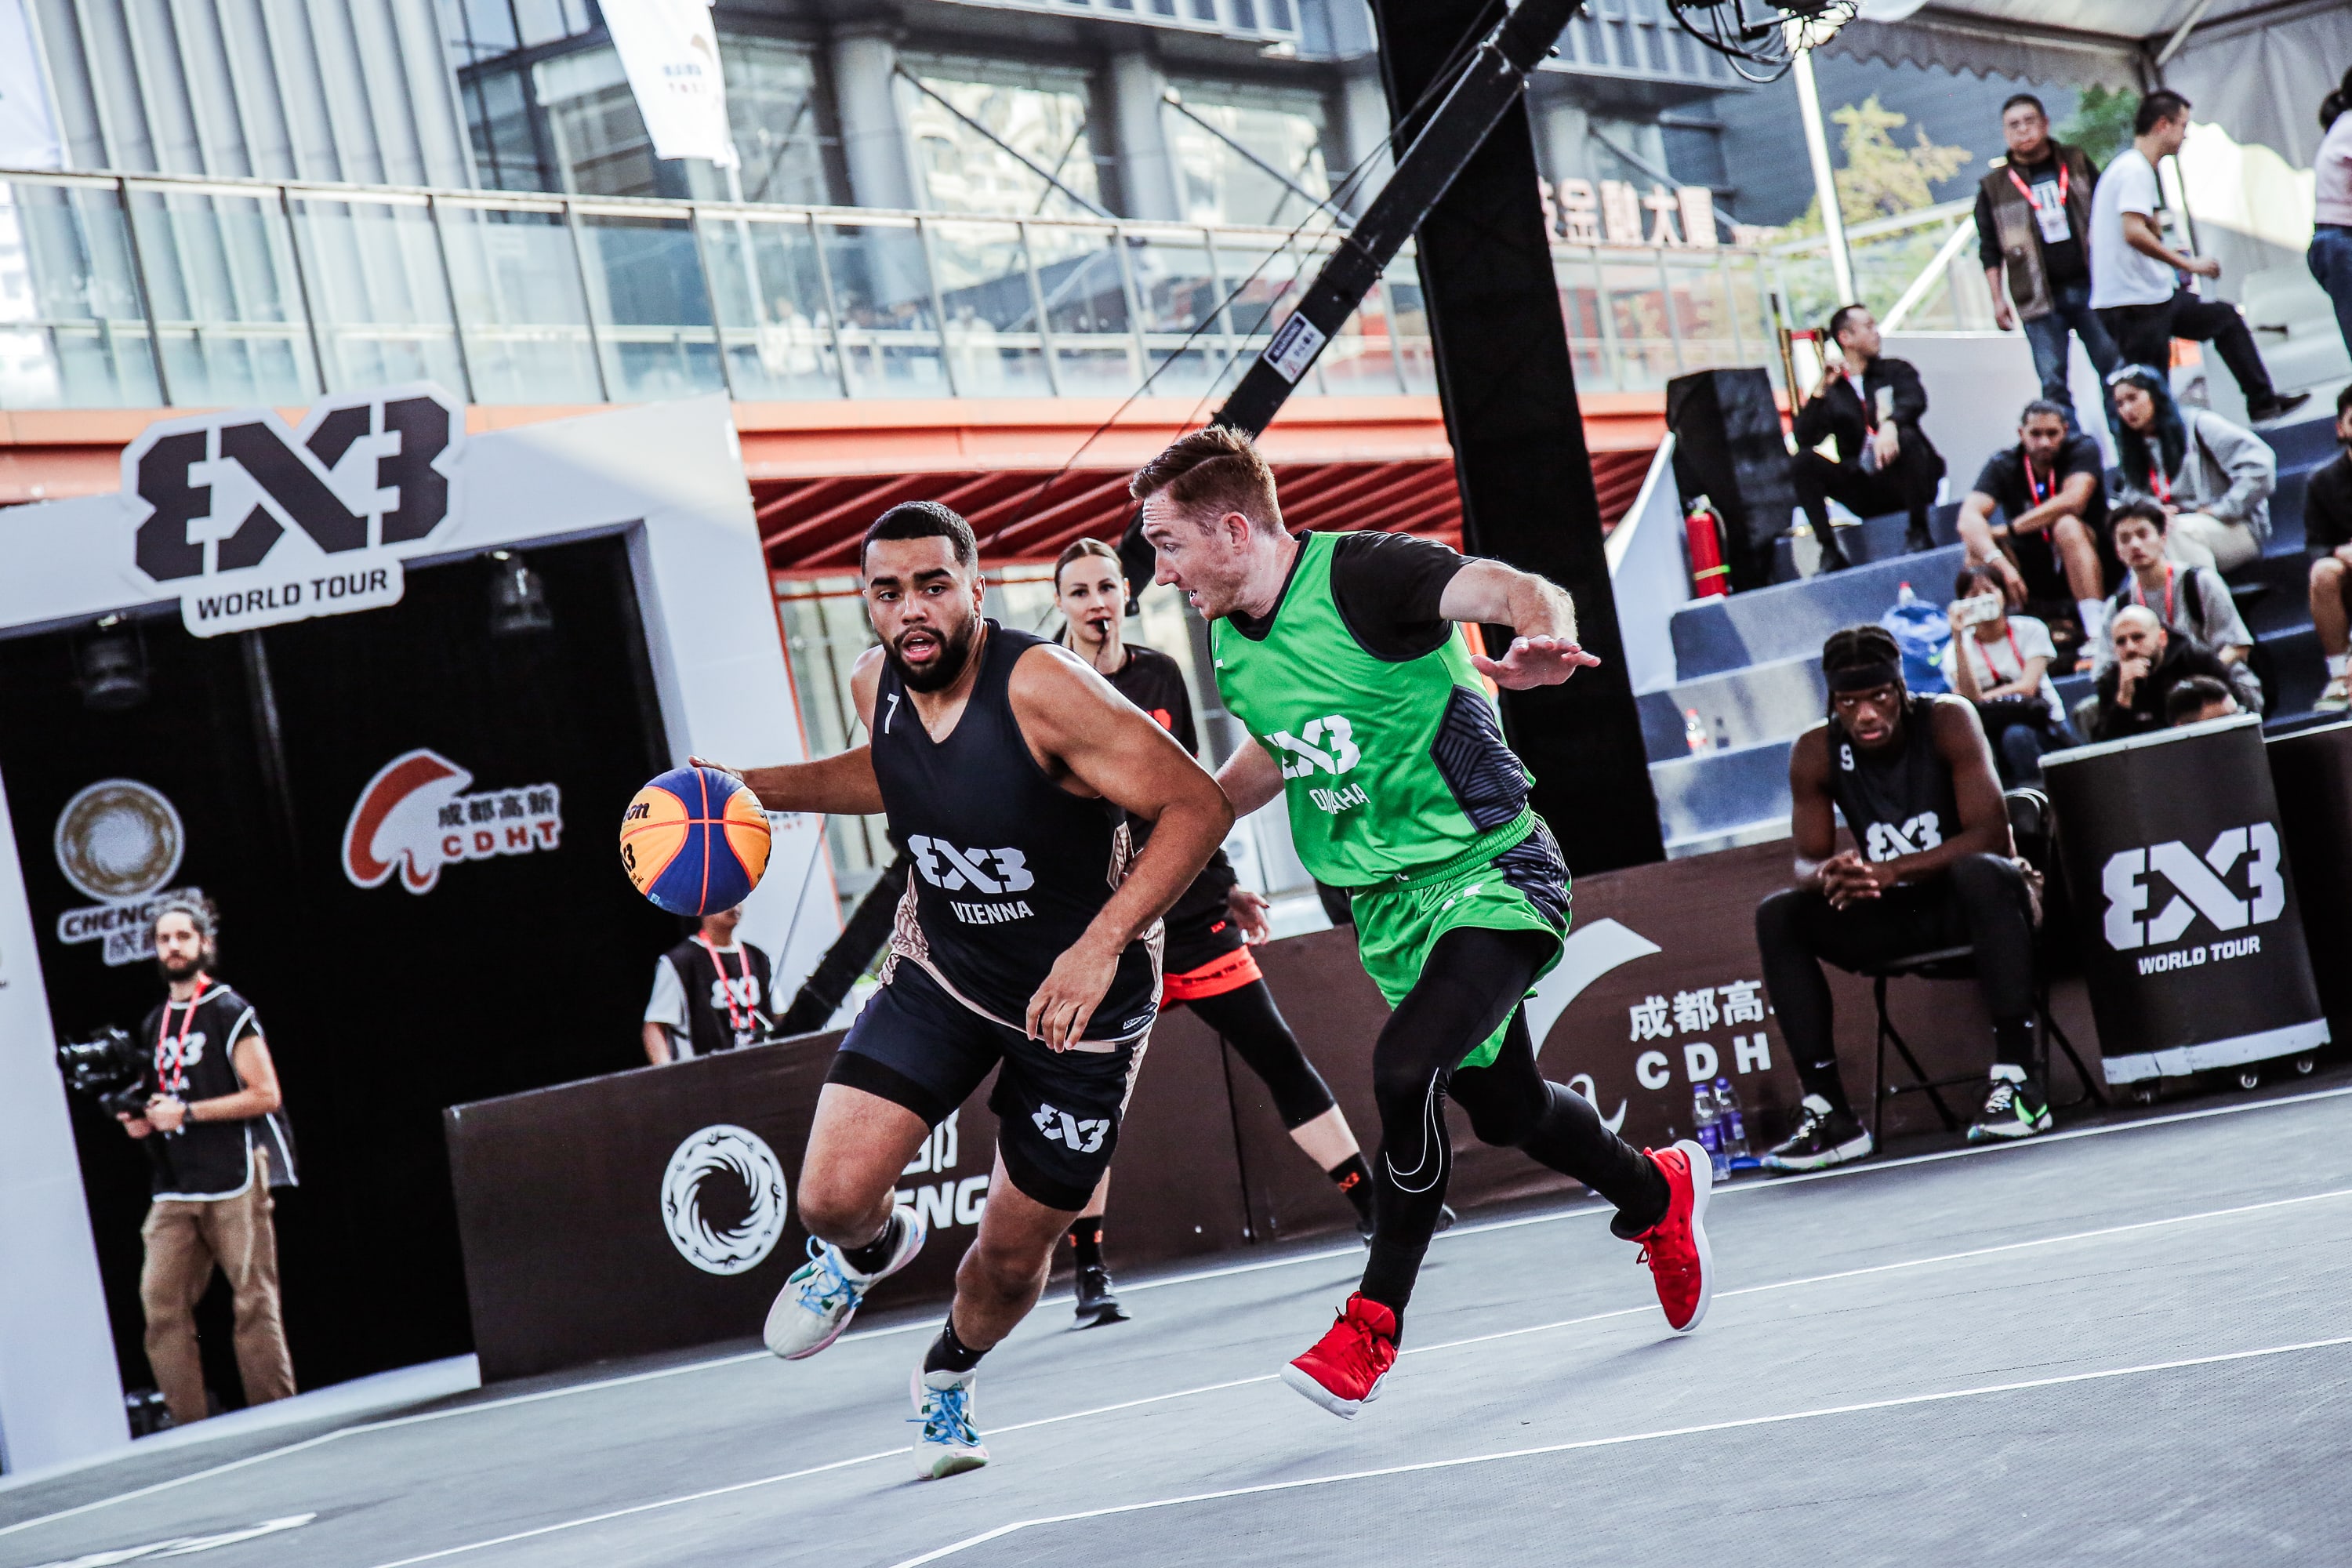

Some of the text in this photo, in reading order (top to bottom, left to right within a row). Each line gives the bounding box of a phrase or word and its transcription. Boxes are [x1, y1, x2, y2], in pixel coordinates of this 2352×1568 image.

[197, 568, 387, 620] WORLD TOUR
[884, 693, 900, 735] 7
[1840, 742, 1855, 772] 9
[437, 789, 554, 829] 成都高新
[441, 820, 556, 857] CDHT
[949, 901, 1034, 924] VIENNA
[2137, 935, 2260, 975] WORLD TOUR
[1629, 979, 1774, 1042] 成都高
[1635, 1033, 1772, 1090] CDH
